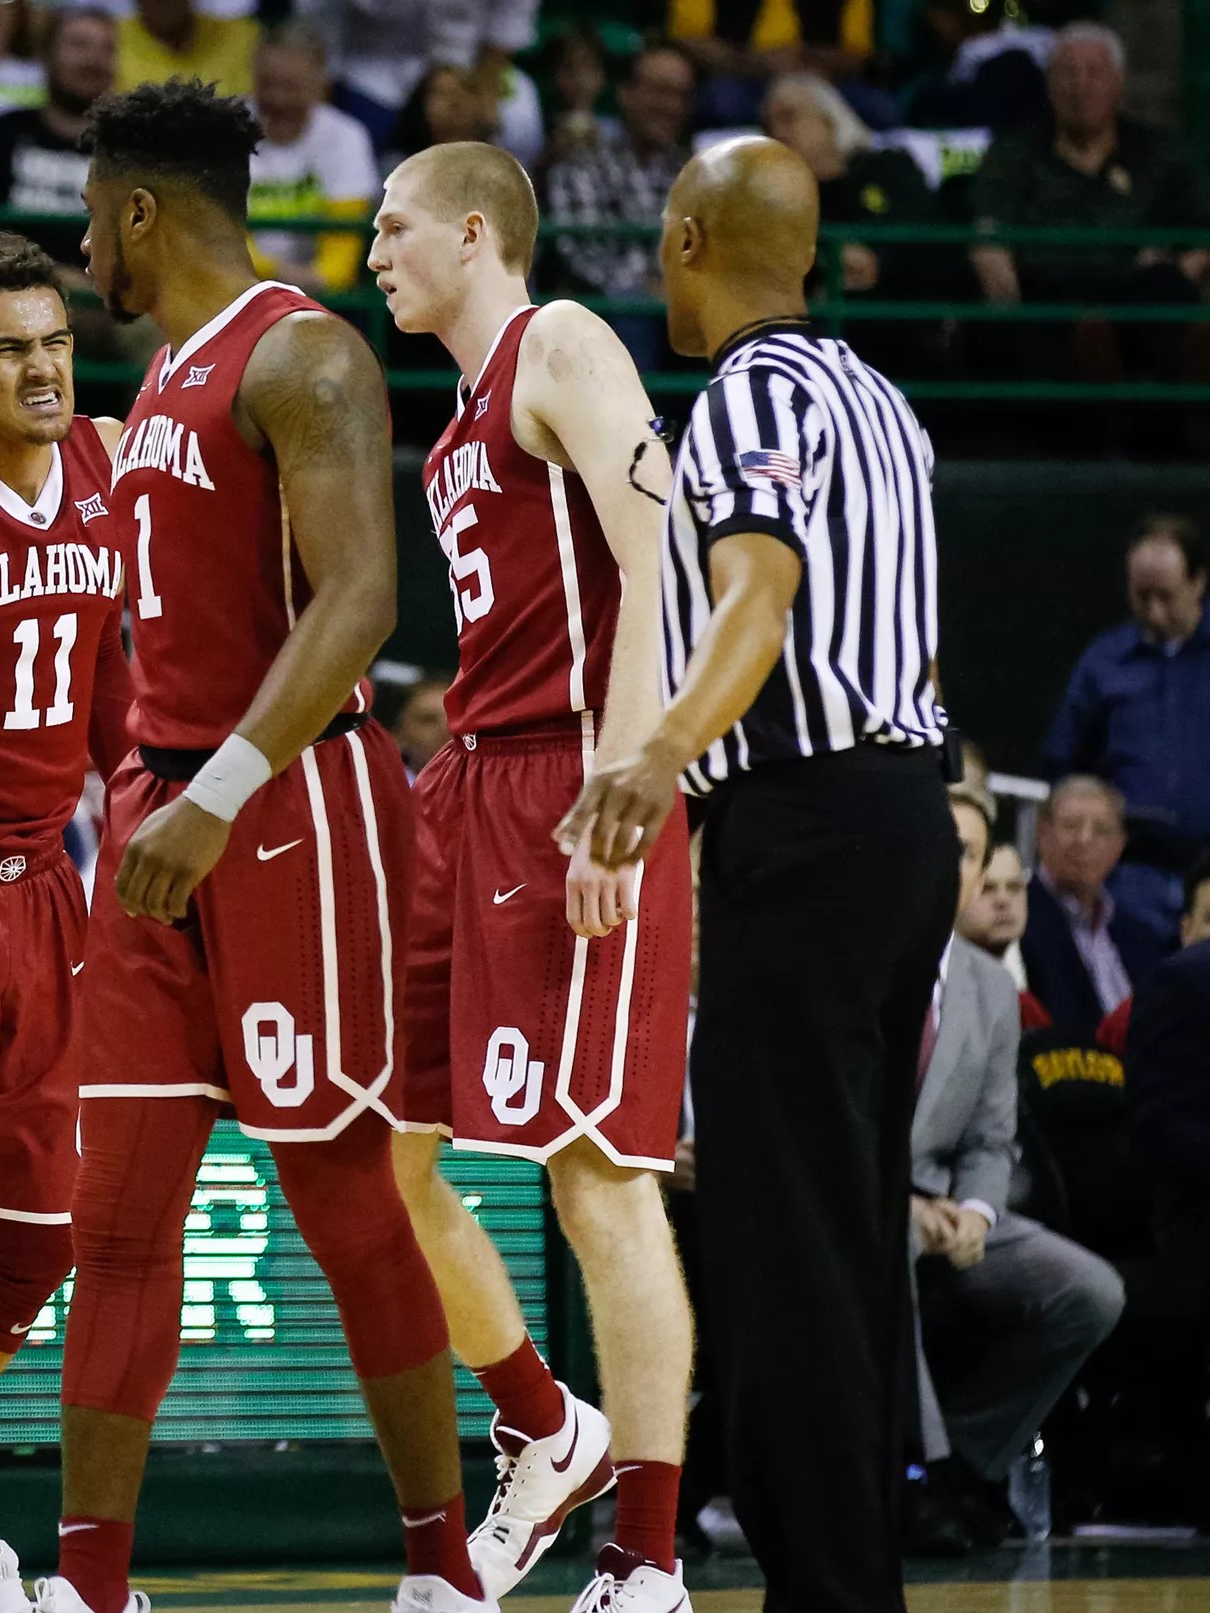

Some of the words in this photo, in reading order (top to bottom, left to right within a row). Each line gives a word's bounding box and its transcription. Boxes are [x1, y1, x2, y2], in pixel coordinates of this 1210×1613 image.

[110, 414, 216, 495] LAHOMA
[134, 493, 163, 620] 1
[3, 612, 78, 730] 11
[241, 1001, 315, 1108] OU
[482, 1025, 545, 1126] OU
